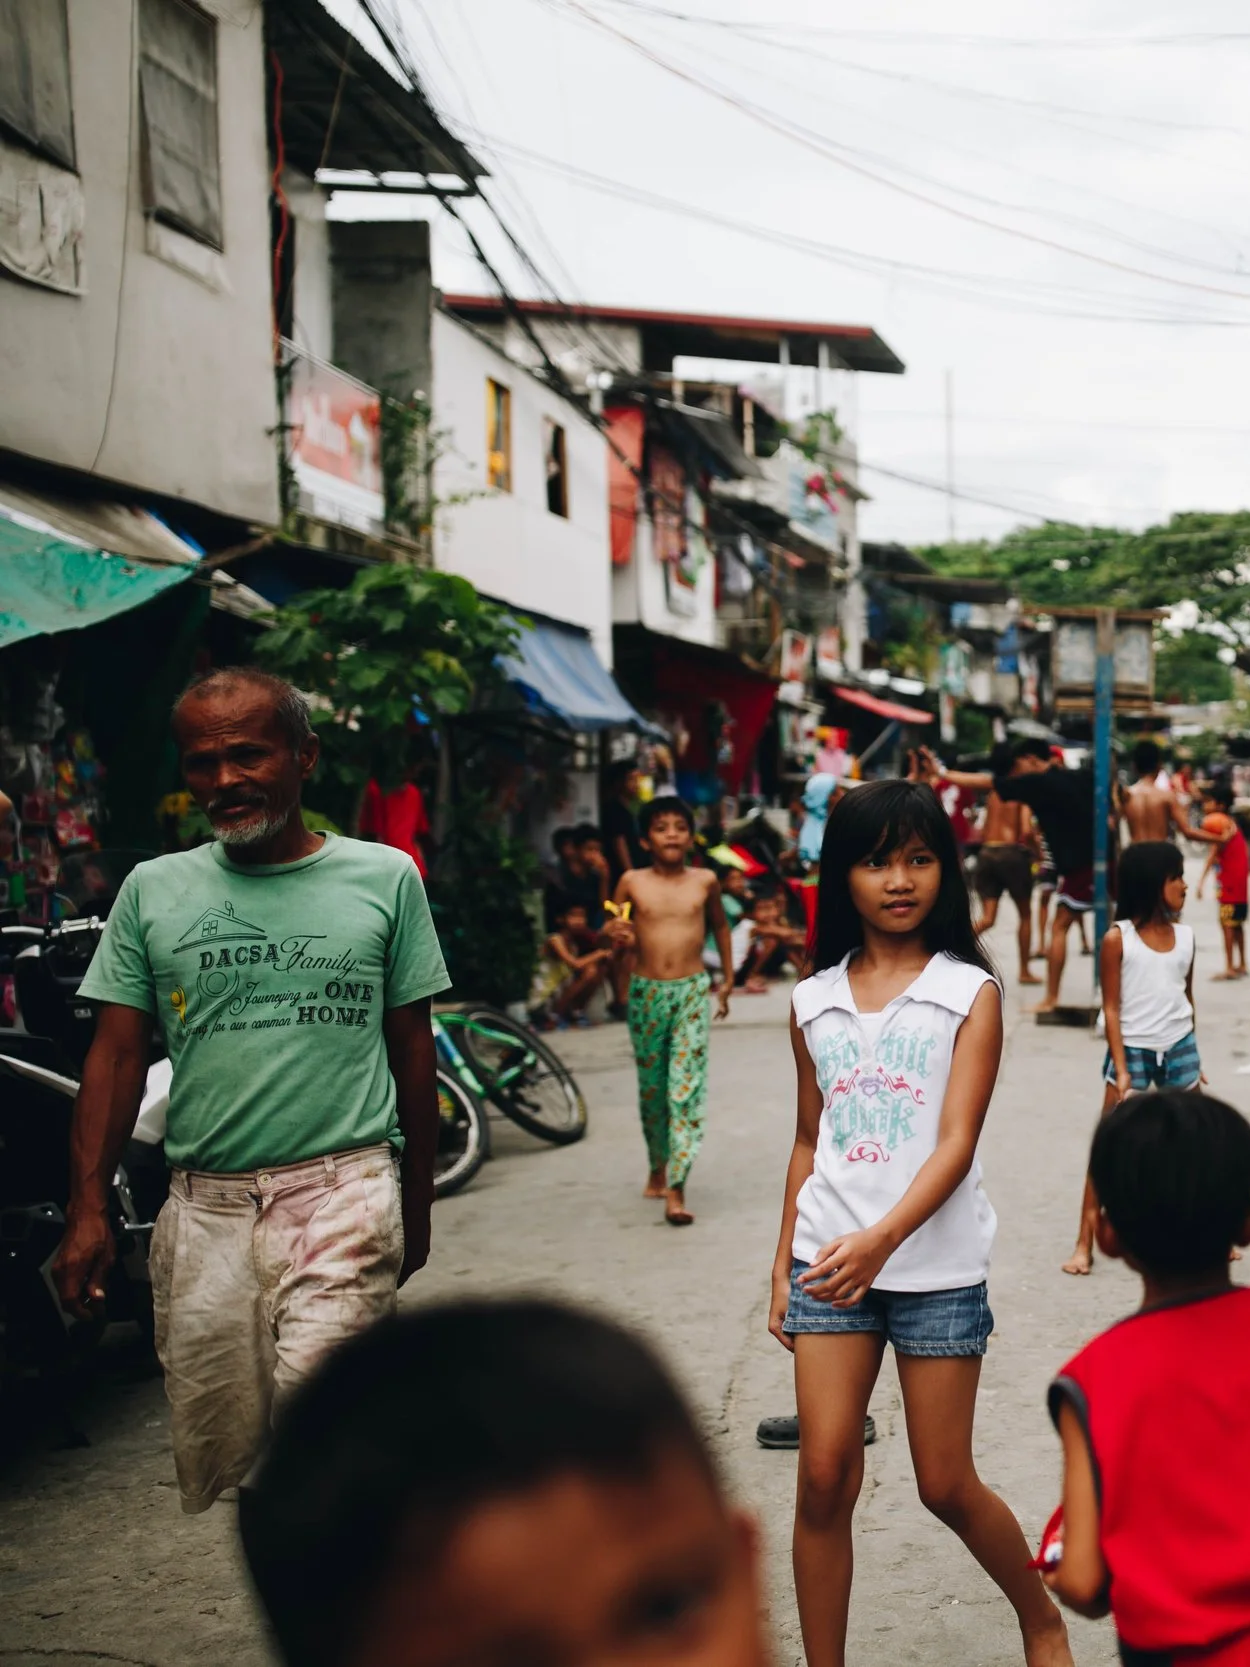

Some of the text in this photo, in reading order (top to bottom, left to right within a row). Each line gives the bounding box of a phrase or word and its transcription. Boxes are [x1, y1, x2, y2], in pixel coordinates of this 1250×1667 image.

[198, 935, 362, 980] DACSA Family:
[229, 981, 375, 1016] Journeying as ONE
[209, 1015, 226, 1040] for
[229, 1020, 248, 1031] our
[251, 1017, 292, 1030] common
[296, 1005, 370, 1028] HOME
